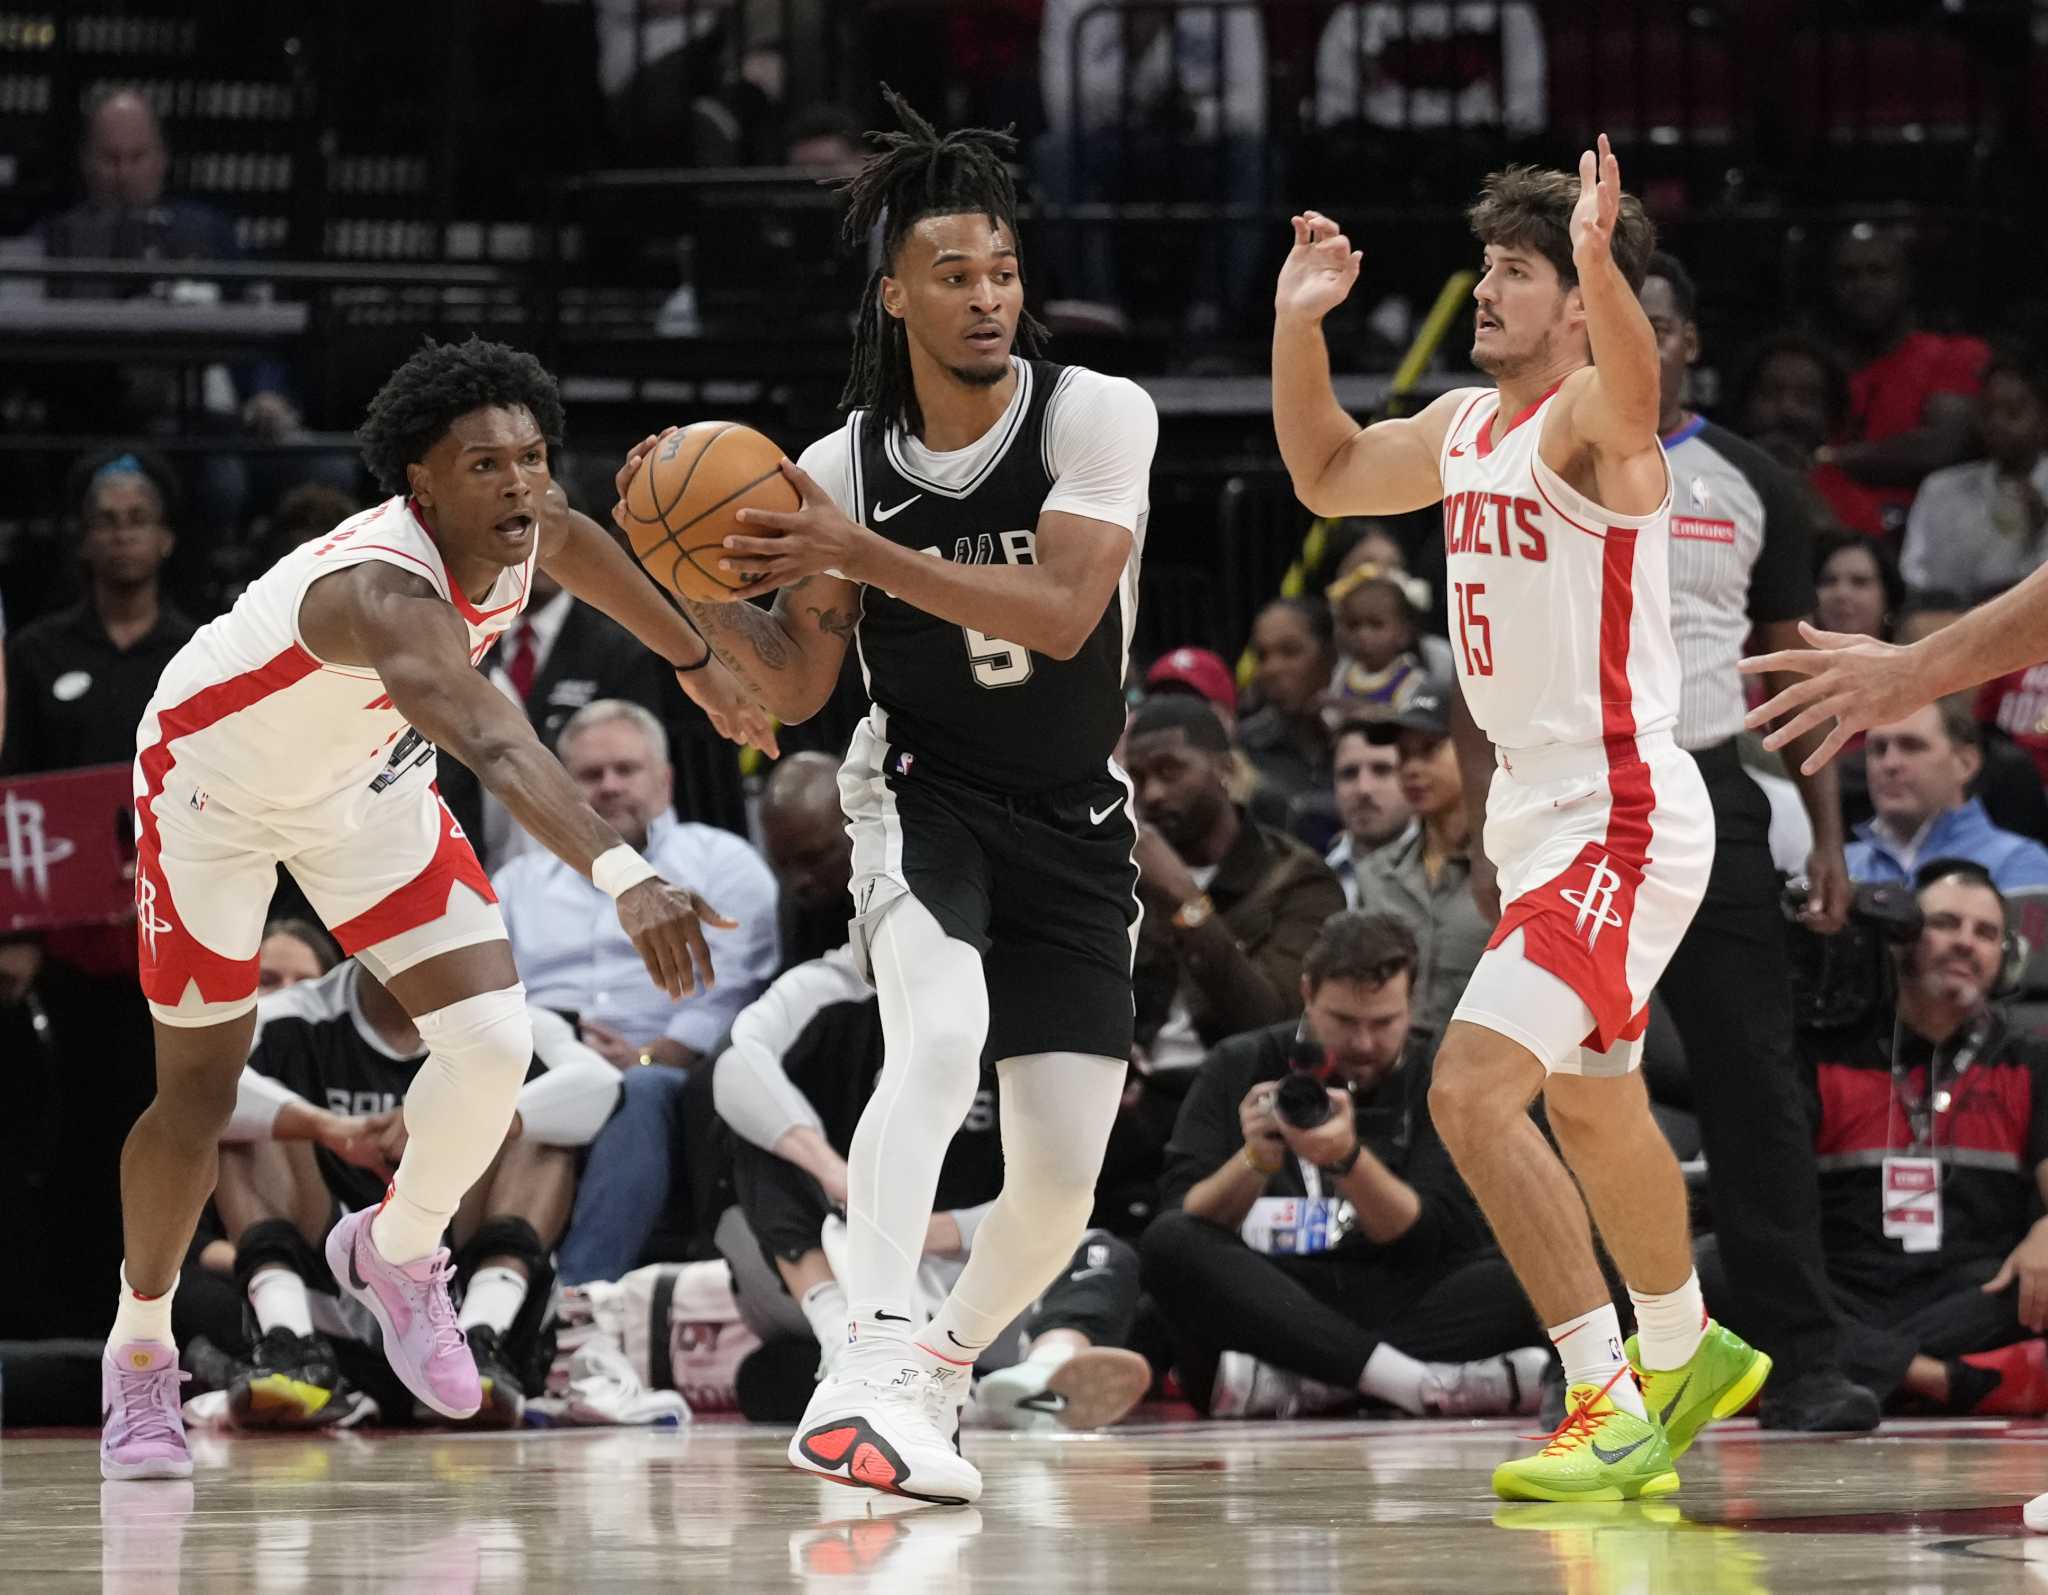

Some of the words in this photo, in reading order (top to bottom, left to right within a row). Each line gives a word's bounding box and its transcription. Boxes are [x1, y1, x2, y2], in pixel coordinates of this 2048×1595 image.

[1672, 519, 1733, 539] Emirates
[963, 626, 1034, 689] 5
[1454, 582, 1493, 676] 15
